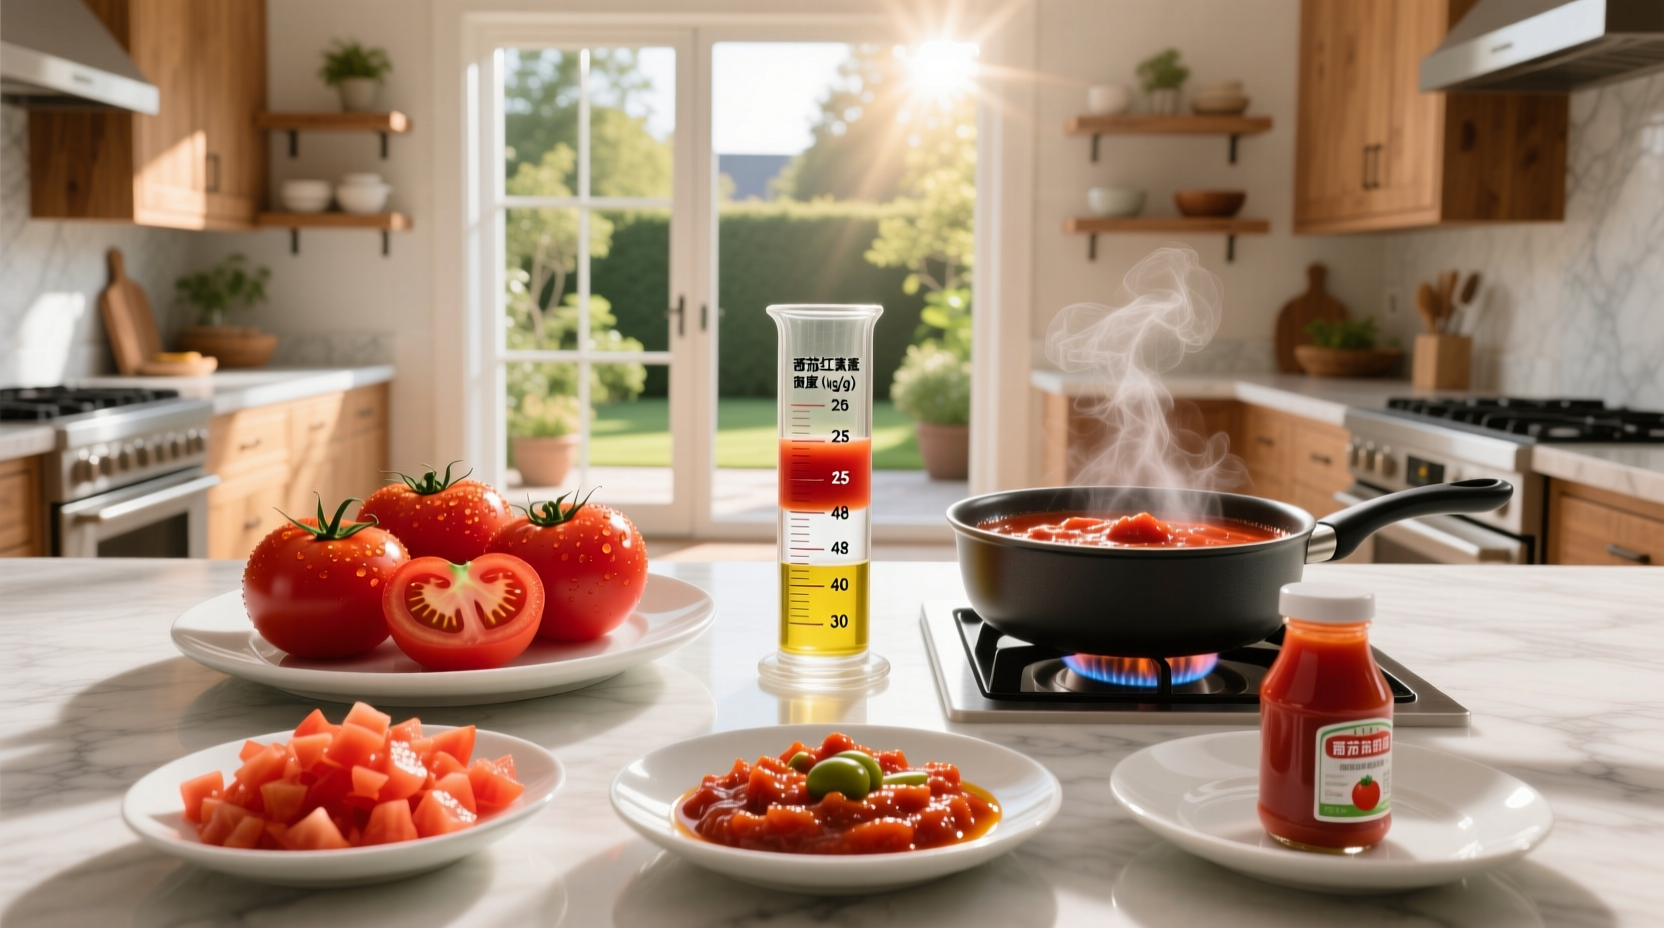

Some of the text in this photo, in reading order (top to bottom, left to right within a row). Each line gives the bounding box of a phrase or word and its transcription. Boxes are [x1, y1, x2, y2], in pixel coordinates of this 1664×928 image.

[831, 398, 849, 411] 26
[831, 429, 850, 443] 25
[831, 470, 850, 485] 25
[830, 505, 849, 520] 48
[830, 578, 849, 591] 40
[830, 614, 848, 628] 30
